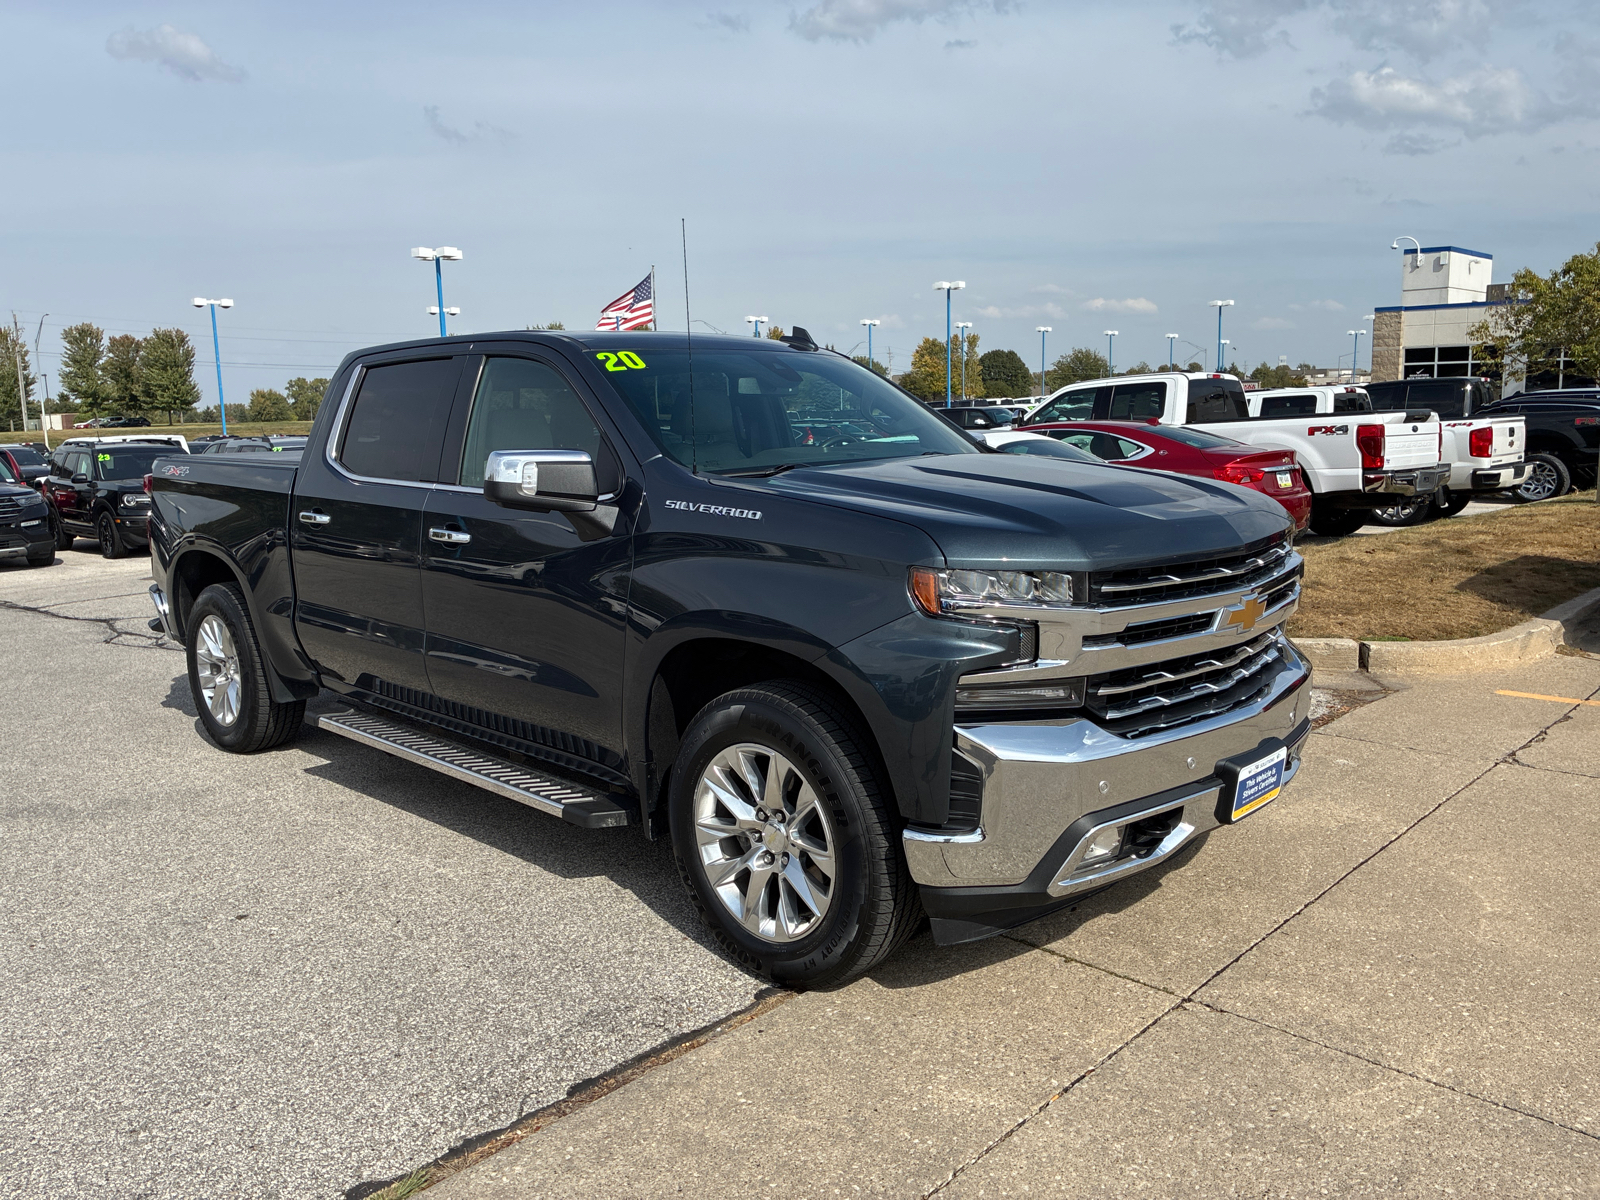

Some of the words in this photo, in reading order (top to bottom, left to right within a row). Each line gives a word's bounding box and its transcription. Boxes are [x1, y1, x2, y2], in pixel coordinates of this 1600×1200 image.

[596, 351, 646, 372] 20
[1308, 424, 1349, 436] FX4
[97, 453, 111, 462] 23
[664, 499, 763, 521] SILVERADO
[750, 713, 850, 828] WRANGLER
[1246, 778, 1255, 788] This
[1256, 770, 1271, 783] Vehicle
[1272, 767, 1276, 775] is
[1243, 786, 1258, 798] Stivers
[1259, 774, 1277, 789] Certified
